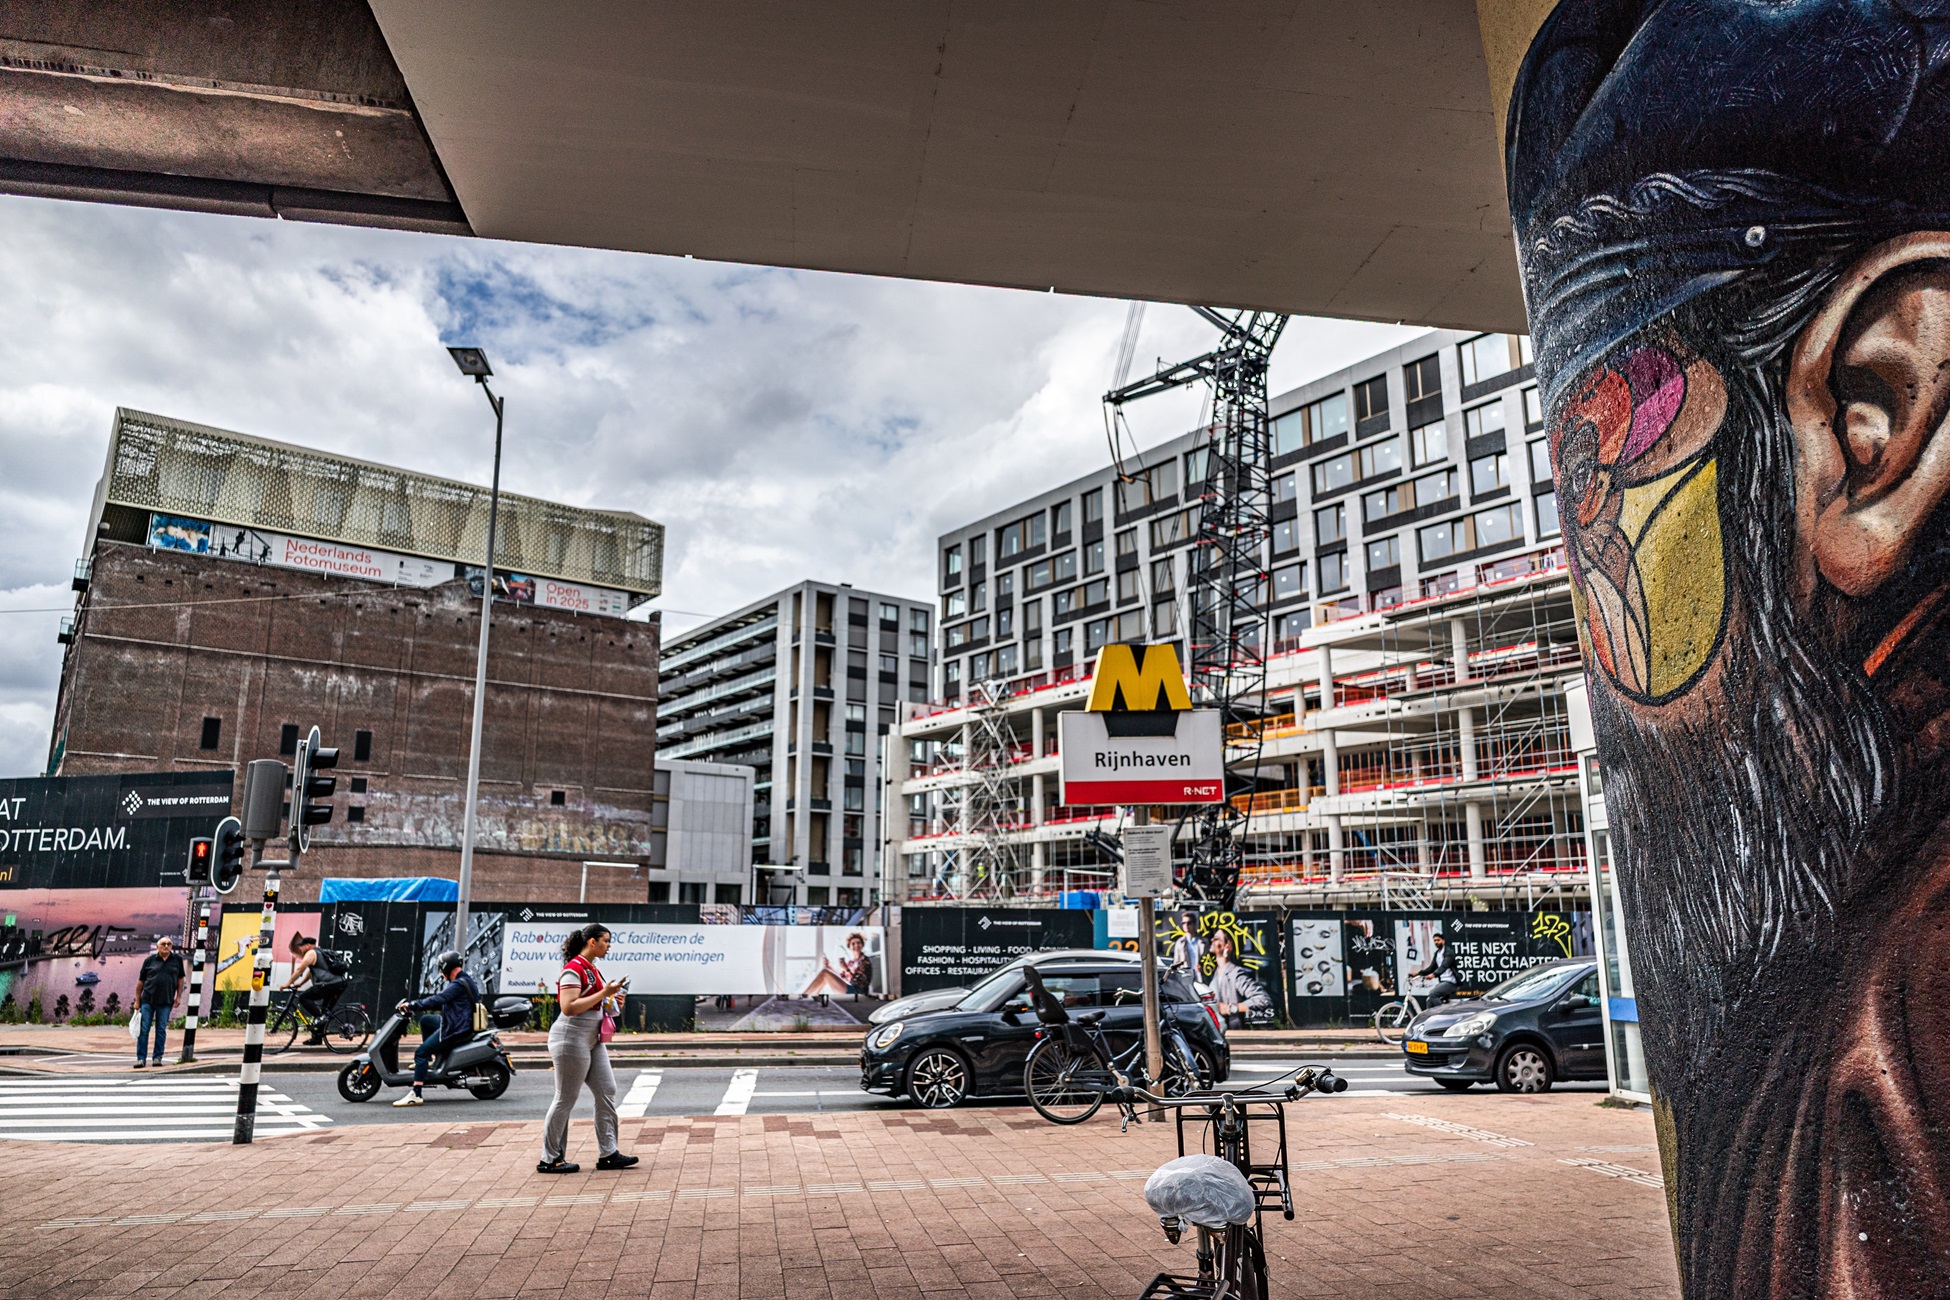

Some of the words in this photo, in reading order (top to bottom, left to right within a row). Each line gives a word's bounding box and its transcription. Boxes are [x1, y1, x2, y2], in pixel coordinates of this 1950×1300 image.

[286, 538, 372, 564] Nederlands
[284, 551, 382, 577] Fotomuseum
[546, 581, 581, 598] Open
[546, 594, 557, 604] in
[560, 596, 589, 610] 2025
[1086, 643, 1193, 711] M
[1094, 750, 1191, 771] Rijnhaven
[147, 798, 161, 806] THE
[161, 797, 179, 806] VIEW
[179, 797, 189, 805] OF
[189, 795, 229, 805] ROTTERDAM
[511, 931, 569, 944] Raboban
[627, 931, 689, 945] faciliteren
[690, 931, 705, 945] de
[922, 945, 966, 954] SHOPPING
[973, 945, 1001, 954] LIVING
[1007, 946, 1033, 954] FOOD
[1452, 942, 1478, 955] THE
[1482, 942, 1517, 955] NEXT
[510, 950, 548, 961] bouw
[663, 951, 725, 965] woningen
[917, 956, 955, 964] FASHION
[961, 956, 1014, 964] HOSPITALITY
[1455, 956, 1496, 969] GREAT
[905, 967, 941, 975] OFFICES
